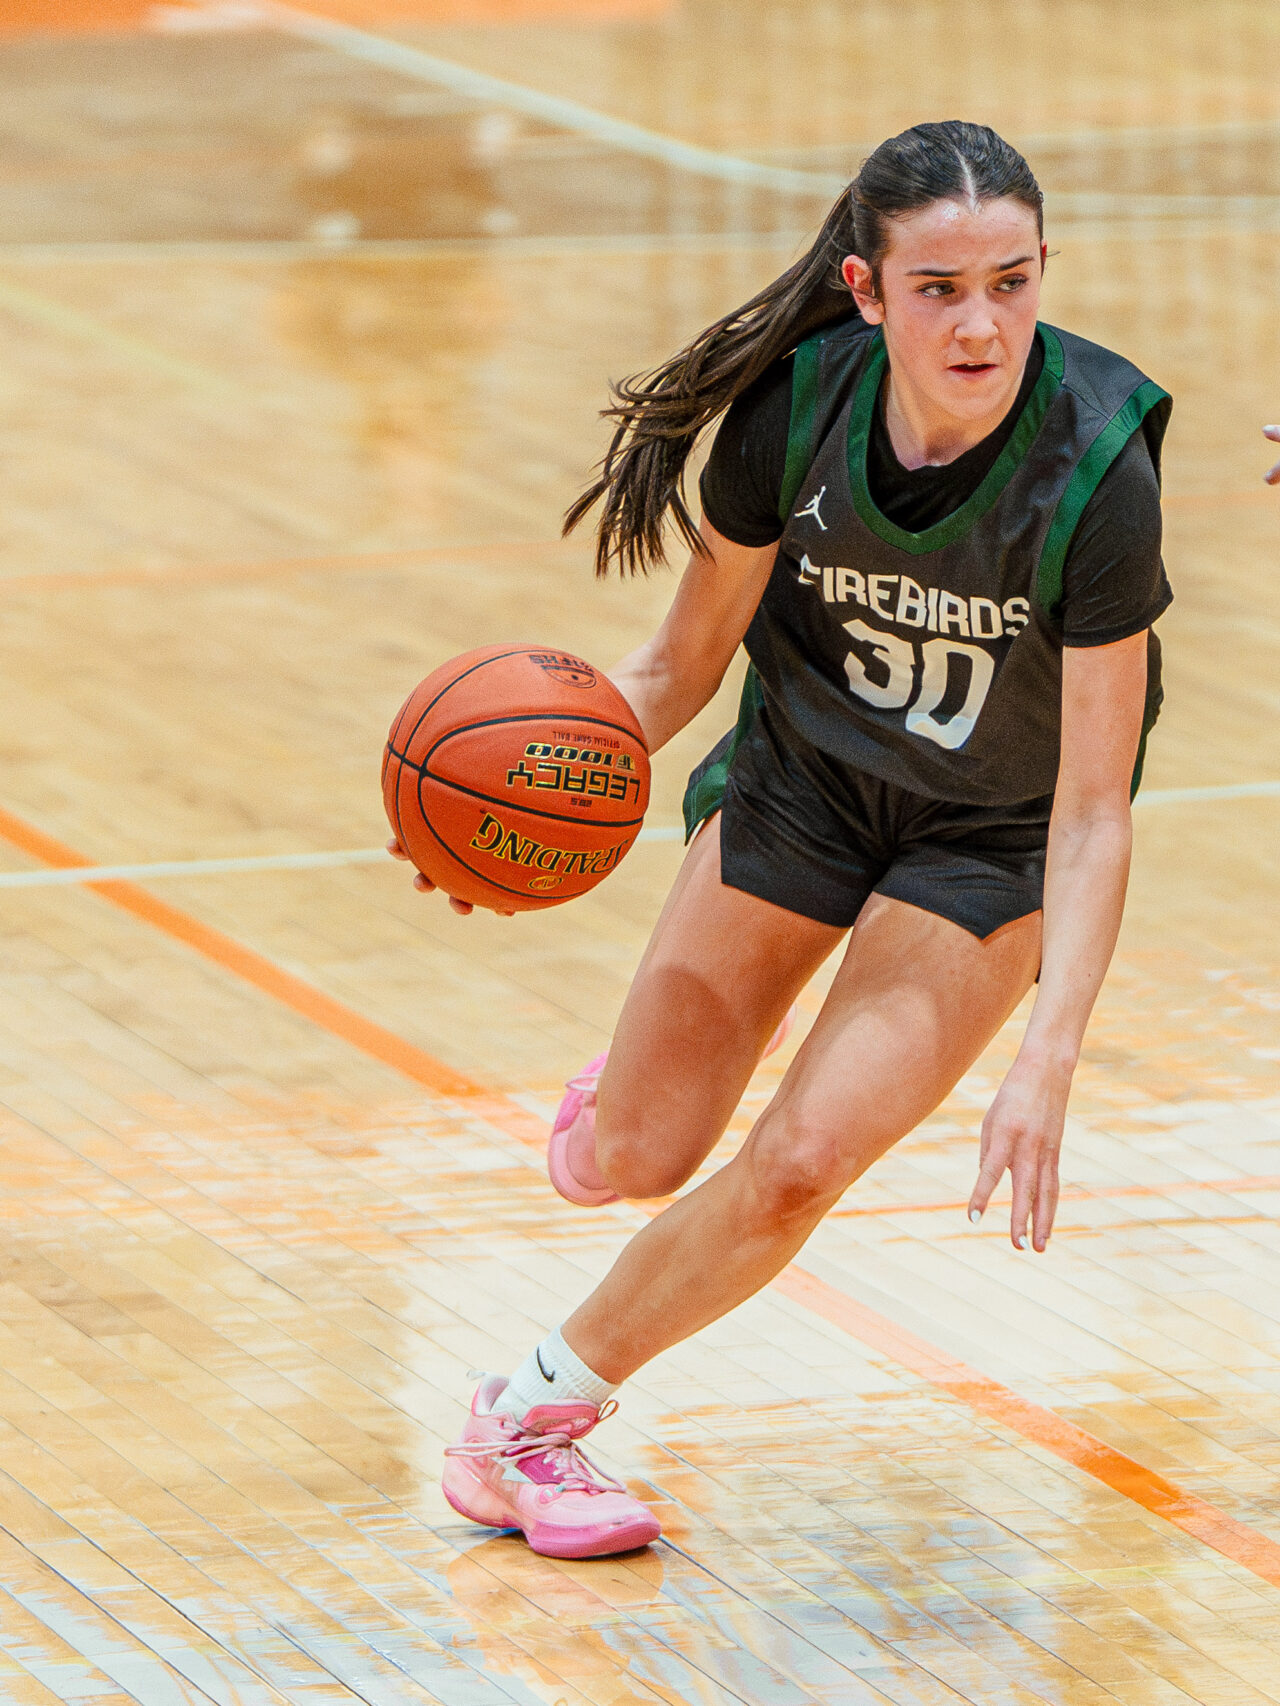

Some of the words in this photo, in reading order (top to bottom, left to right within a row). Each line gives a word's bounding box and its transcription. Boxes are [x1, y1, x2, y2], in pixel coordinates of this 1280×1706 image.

[798, 554, 1030, 639] FIREBIRDS
[842, 618, 996, 750] 30
[552, 731, 571, 742] BALL
[574, 734, 592, 745] GAME
[594, 736, 621, 750] OFFICIAL
[525, 742, 613, 767] 1000
[506, 761, 640, 805] LEGACY
[470, 811, 629, 875] SPALDING
